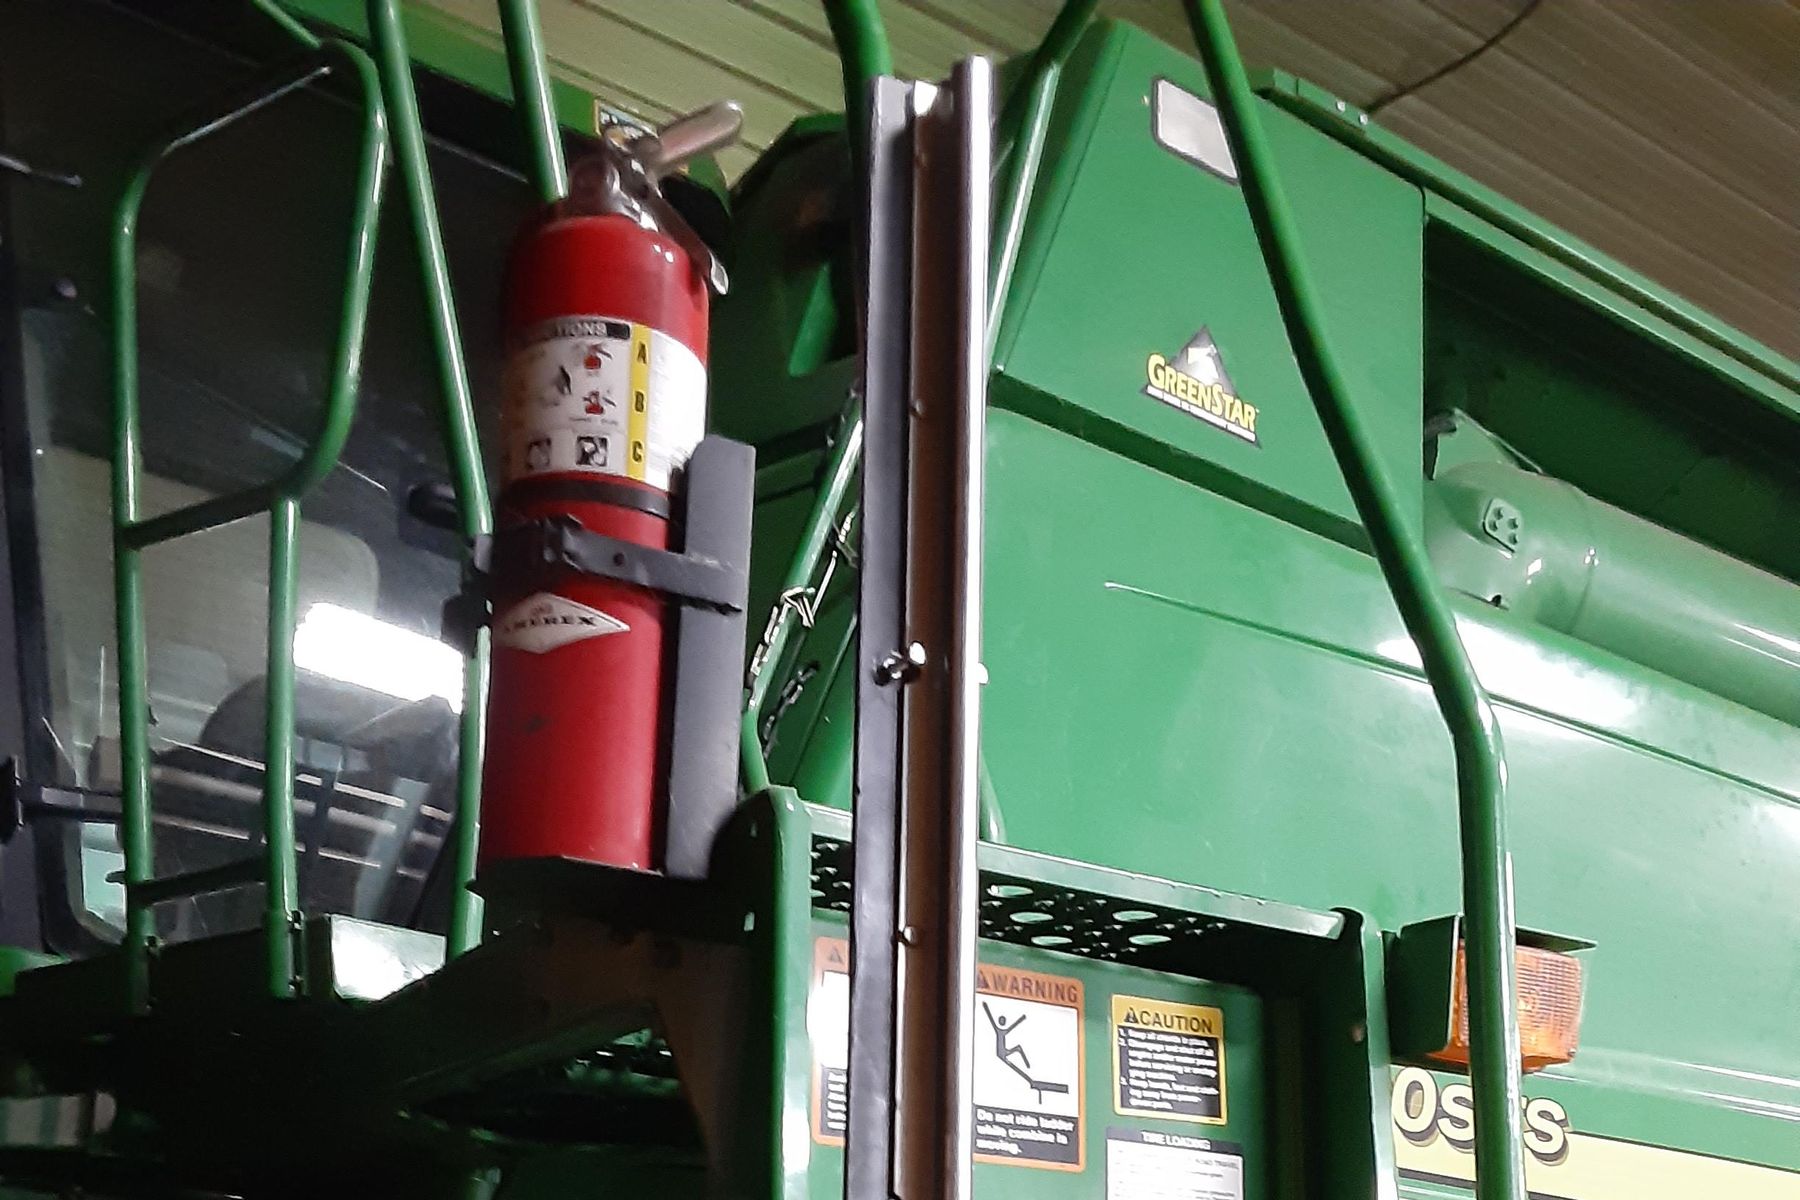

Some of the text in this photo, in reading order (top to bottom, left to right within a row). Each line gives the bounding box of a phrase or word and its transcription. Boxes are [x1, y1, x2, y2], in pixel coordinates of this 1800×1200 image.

[637, 341, 648, 365] A
[634, 391, 645, 413] B
[632, 441, 644, 463] C
[992, 972, 1078, 1003] WARNING
[1140, 1010, 1213, 1034] CAUTION
